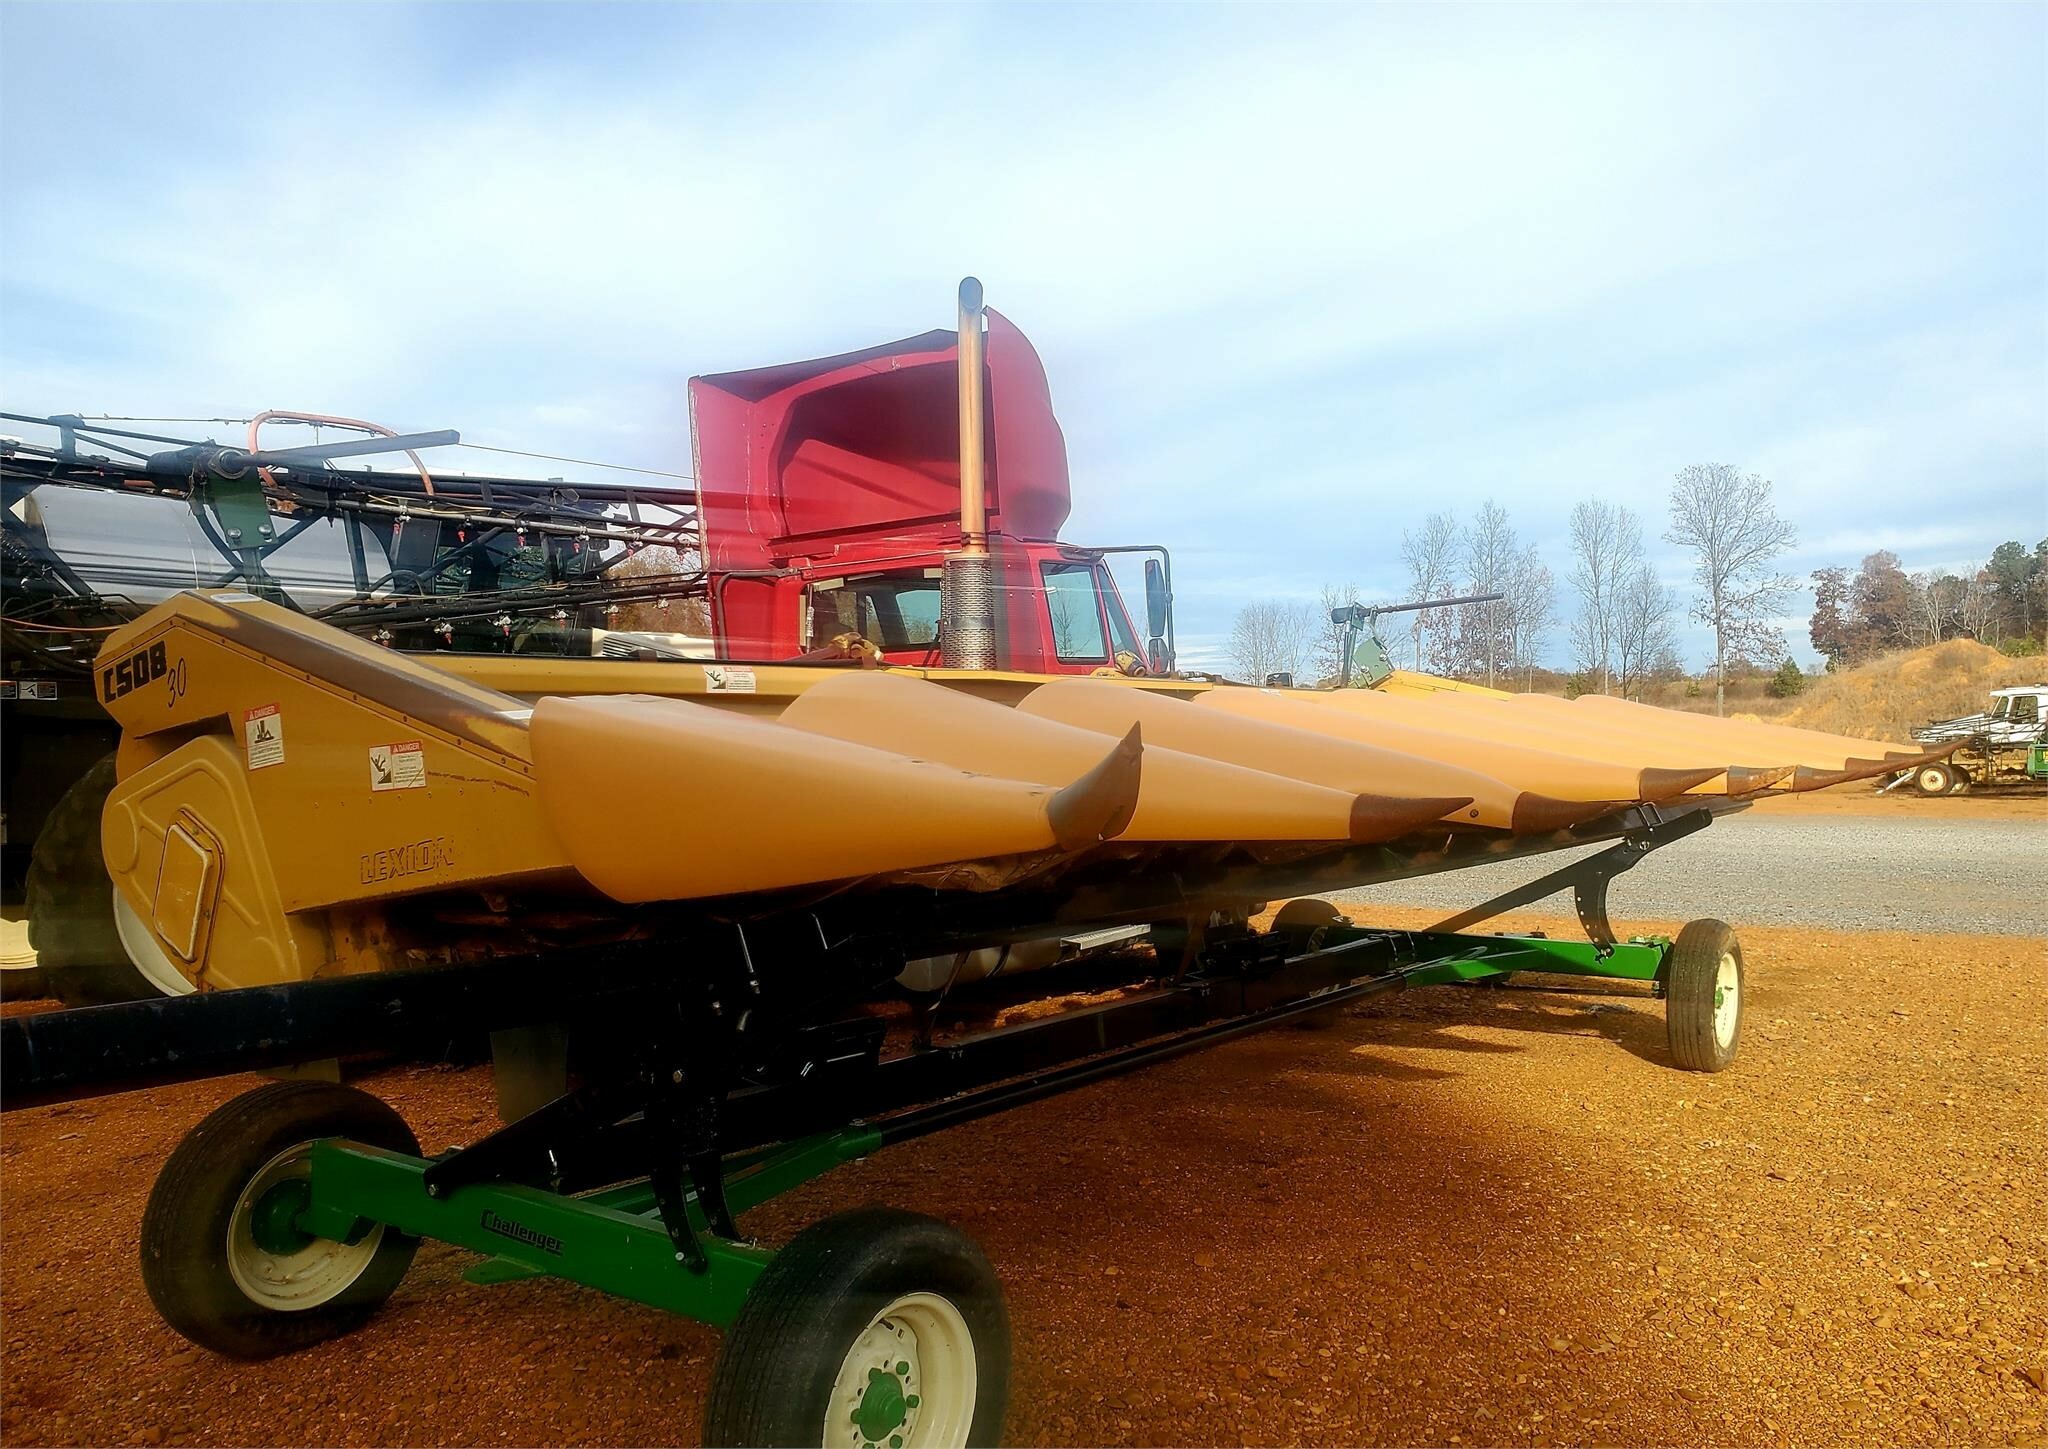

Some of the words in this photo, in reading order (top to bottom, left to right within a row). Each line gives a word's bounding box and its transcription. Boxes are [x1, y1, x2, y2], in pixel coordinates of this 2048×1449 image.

[167, 657, 187, 708] 30
[398, 742, 420, 752] DANGER
[361, 836, 455, 885] LEXION
[481, 1209, 565, 1257] Challenger
